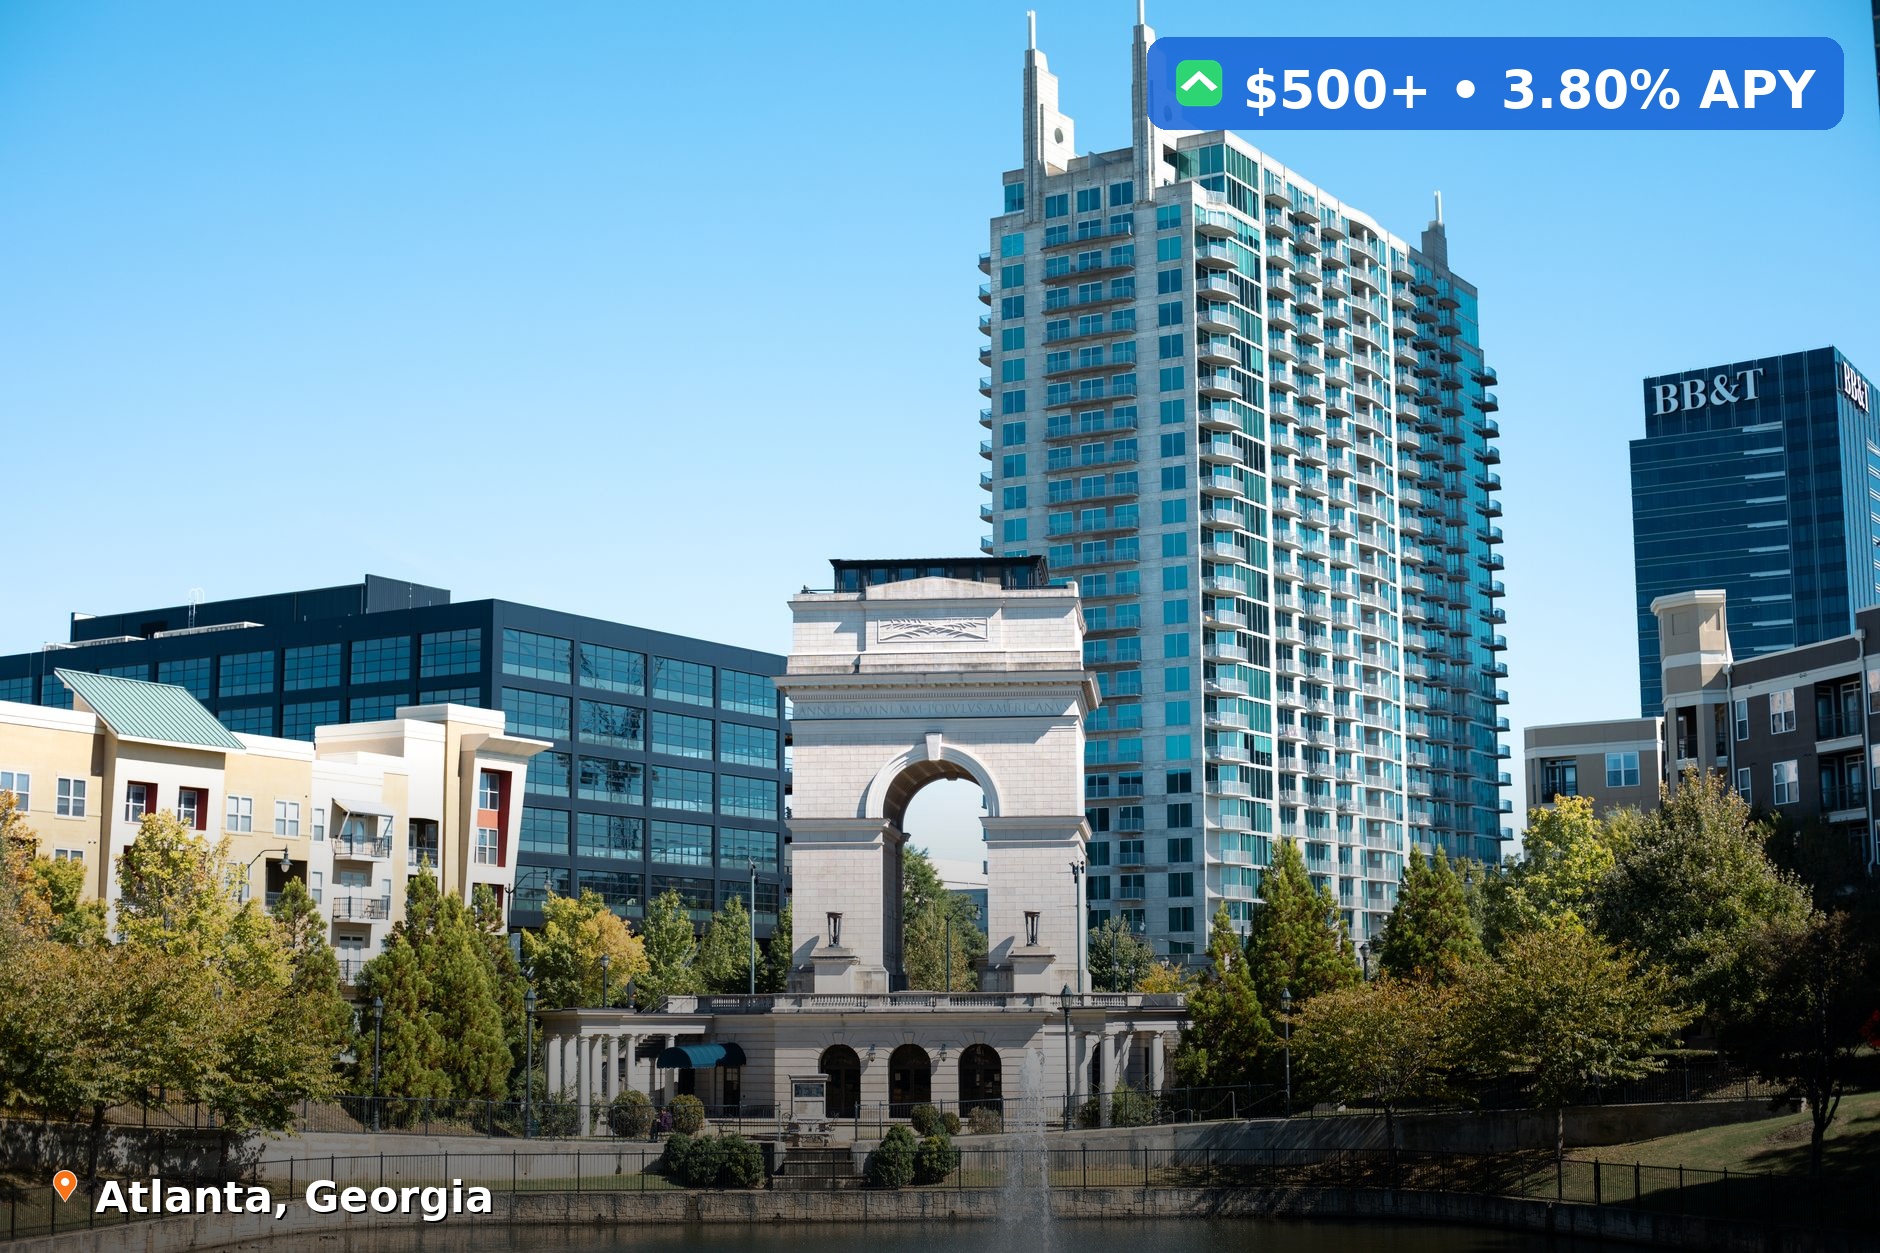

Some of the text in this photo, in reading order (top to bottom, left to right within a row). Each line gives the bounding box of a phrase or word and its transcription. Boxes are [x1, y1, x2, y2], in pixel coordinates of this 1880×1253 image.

[1652, 368, 1764, 416] BB&T
[1842, 360, 1870, 413] BB&T
[799, 703, 838, 715] ANNO
[842, 703, 893, 715] DOMINI
[898, 703, 922, 714] MM
